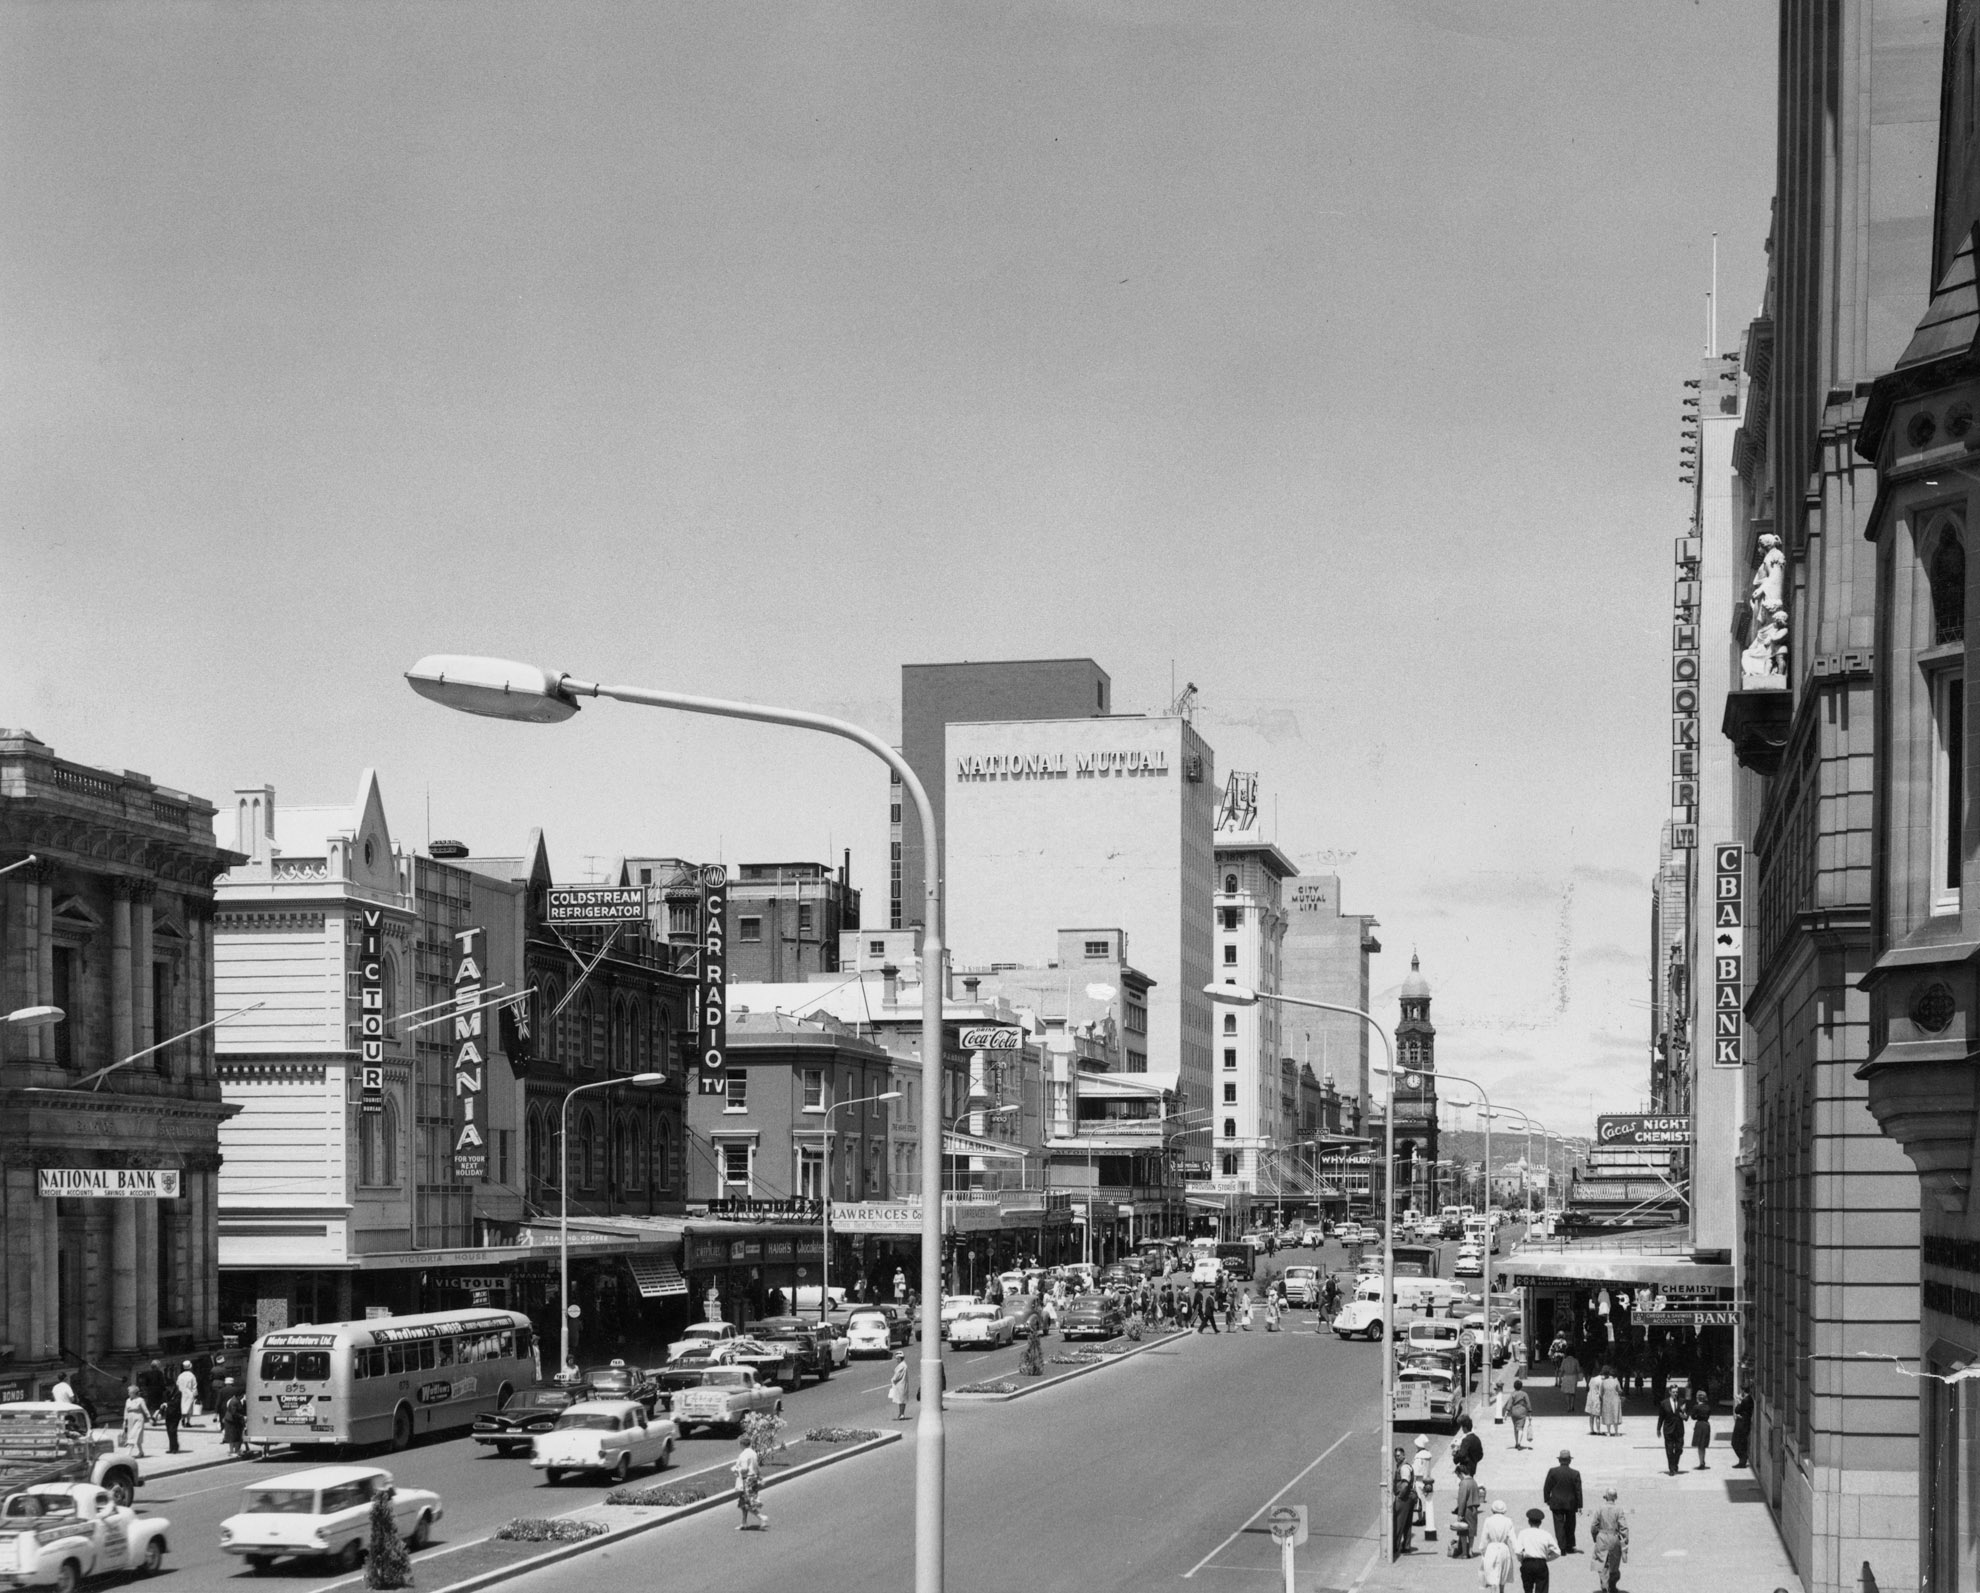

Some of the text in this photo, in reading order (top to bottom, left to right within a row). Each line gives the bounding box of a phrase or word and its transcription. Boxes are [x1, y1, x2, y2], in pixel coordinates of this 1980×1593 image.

[1675, 627, 1697, 804] HOOKER
[957, 751, 1169, 778] NATIONAL MUTUAL
[1676, 829, 1695, 844] LTD
[704, 869, 725, 885] AWA
[1298, 886, 1319, 894] CITY
[551, 891, 642, 905] COLDSTREAM
[1292, 895, 1326, 903] MUTUAL
[551, 906, 641, 918] REFRIGERATOR
[1300, 903, 1318, 912] LIFE
[1718, 849, 1740, 1062] CBA BANK
[705, 896, 723, 1068] CAR RADIO
[364, 911, 381, 1086] VICTOUR
[454, 928, 483, 1151] TASMANIA
[702, 1079, 725, 1093] TV
[1643, 1119, 1689, 1130] NIGHT
[1635, 1132, 1691, 1142] CHEMIST
[1322, 1156, 1346, 1164] WHY
[40, 1170, 157, 1189] NATIONAL BANK
[1217, 1184, 1236, 1192] STORES
[832, 1209, 909, 1220] LAWRENCES
[768, 1243, 792, 1254] HAIGH'S
[399, 1252, 488, 1263] VICTORIA HOUSE
[1661, 1285, 1713, 1293] CHEMIST
[1694, 1312, 1738, 1324] BANK
[287, 1336, 319, 1345] Radiators
[285, 1384, 306, 1393] 875
[2, 1390, 24, 1402] BONDS
